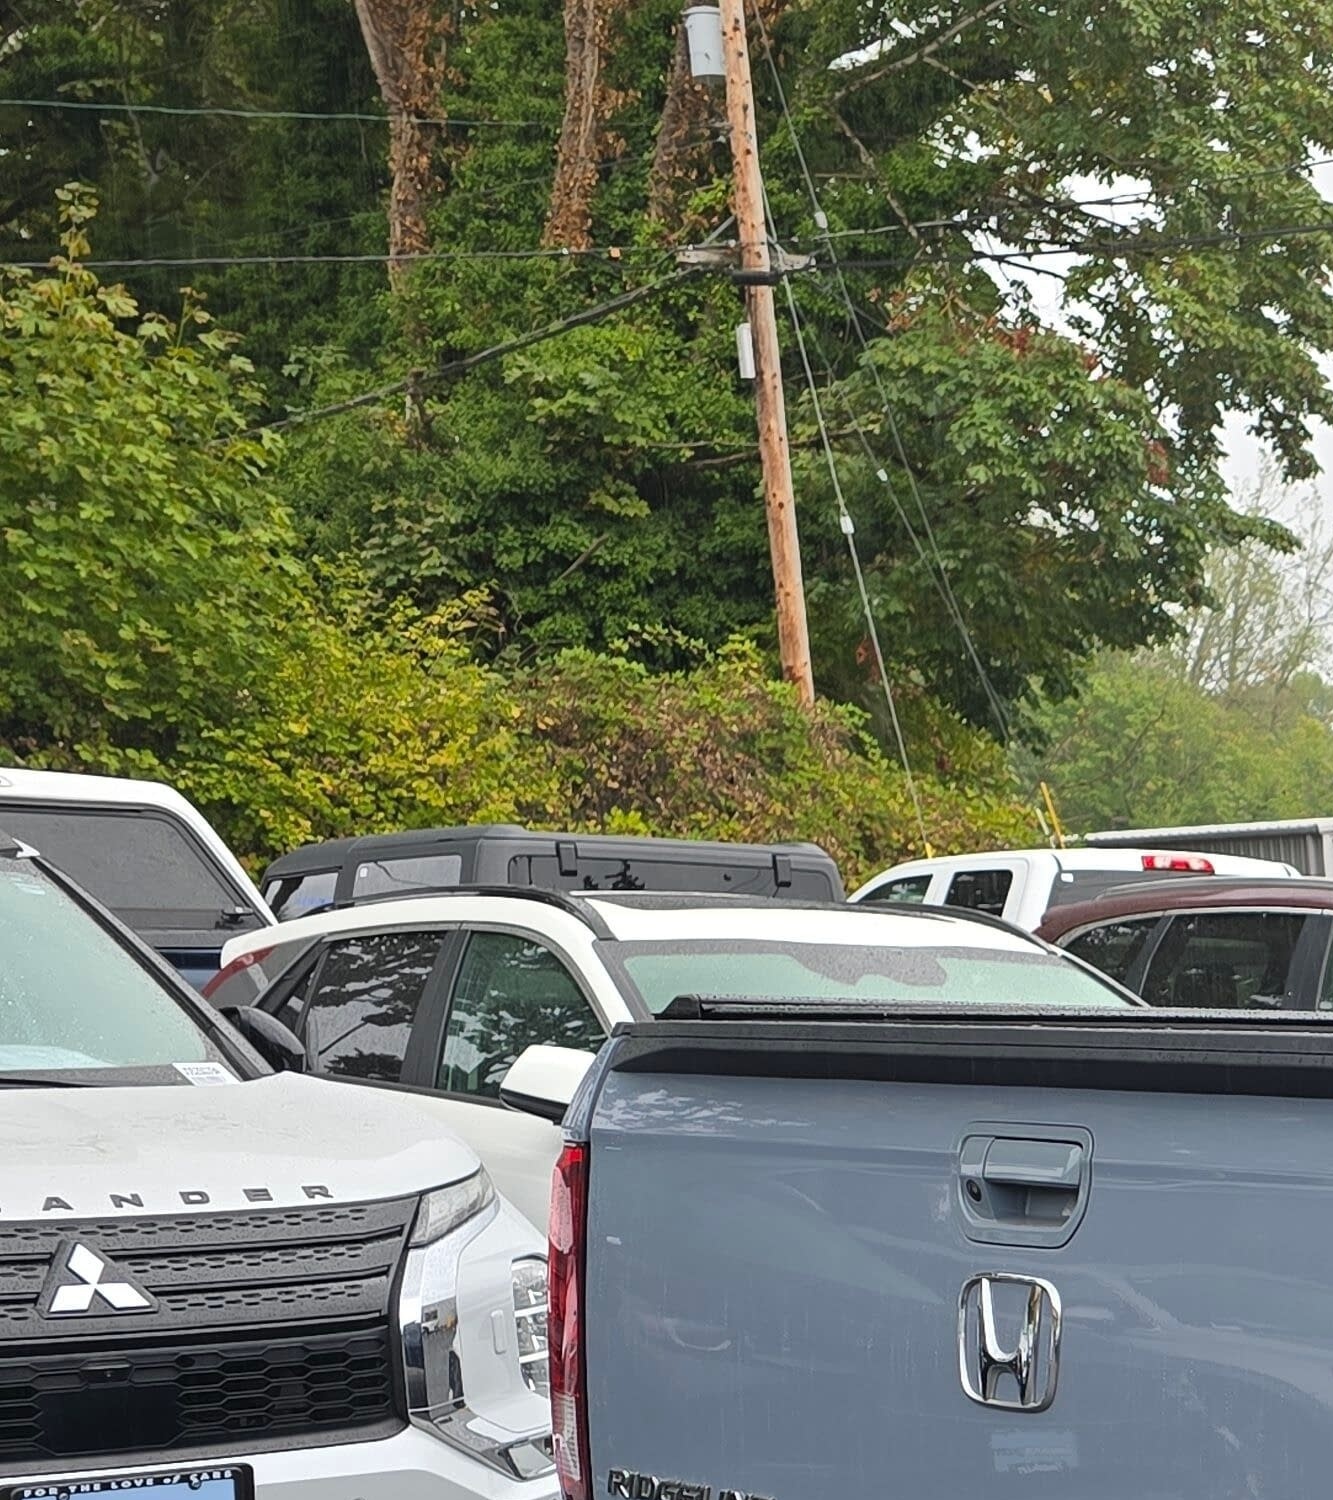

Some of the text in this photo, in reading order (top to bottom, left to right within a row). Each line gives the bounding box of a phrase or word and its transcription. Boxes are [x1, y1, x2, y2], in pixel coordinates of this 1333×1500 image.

[0, 1184, 335, 1213] ANDER
[23, 1486, 58, 1498] FOR
[68, 1482, 101, 1494] THE
[110, 1477, 154, 1490] LOVE
